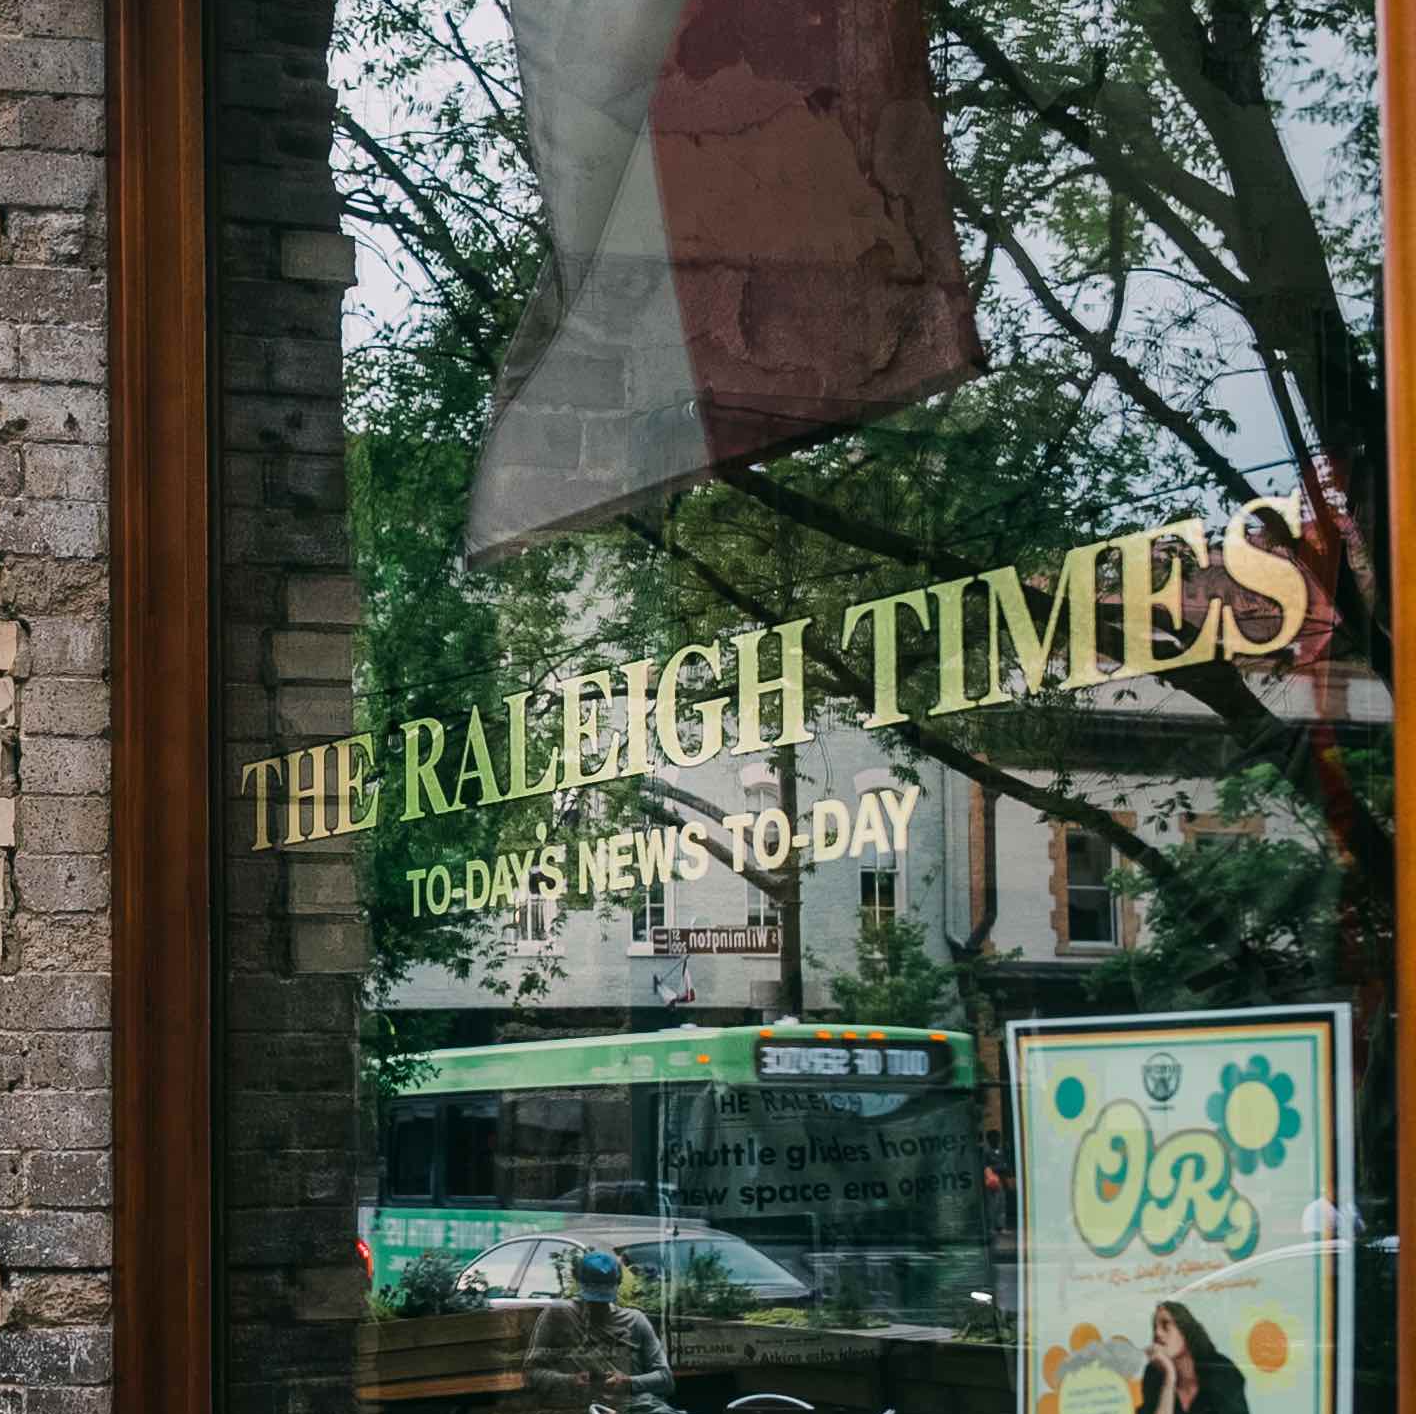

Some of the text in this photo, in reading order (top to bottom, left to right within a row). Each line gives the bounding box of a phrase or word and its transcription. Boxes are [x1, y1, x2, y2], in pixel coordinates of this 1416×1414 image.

[241, 493, 1311, 852] THE RALEIGH TIMES
[405, 783, 923, 918] TO-DAY'S NEWS TO-DAY
[667, 1136, 777, 1169] Shuttle
[786, 1135, 872, 1172] glides
[738, 1179, 832, 1212] space
[842, 1177, 889, 1202] era
[897, 1169, 974, 1201] opens
